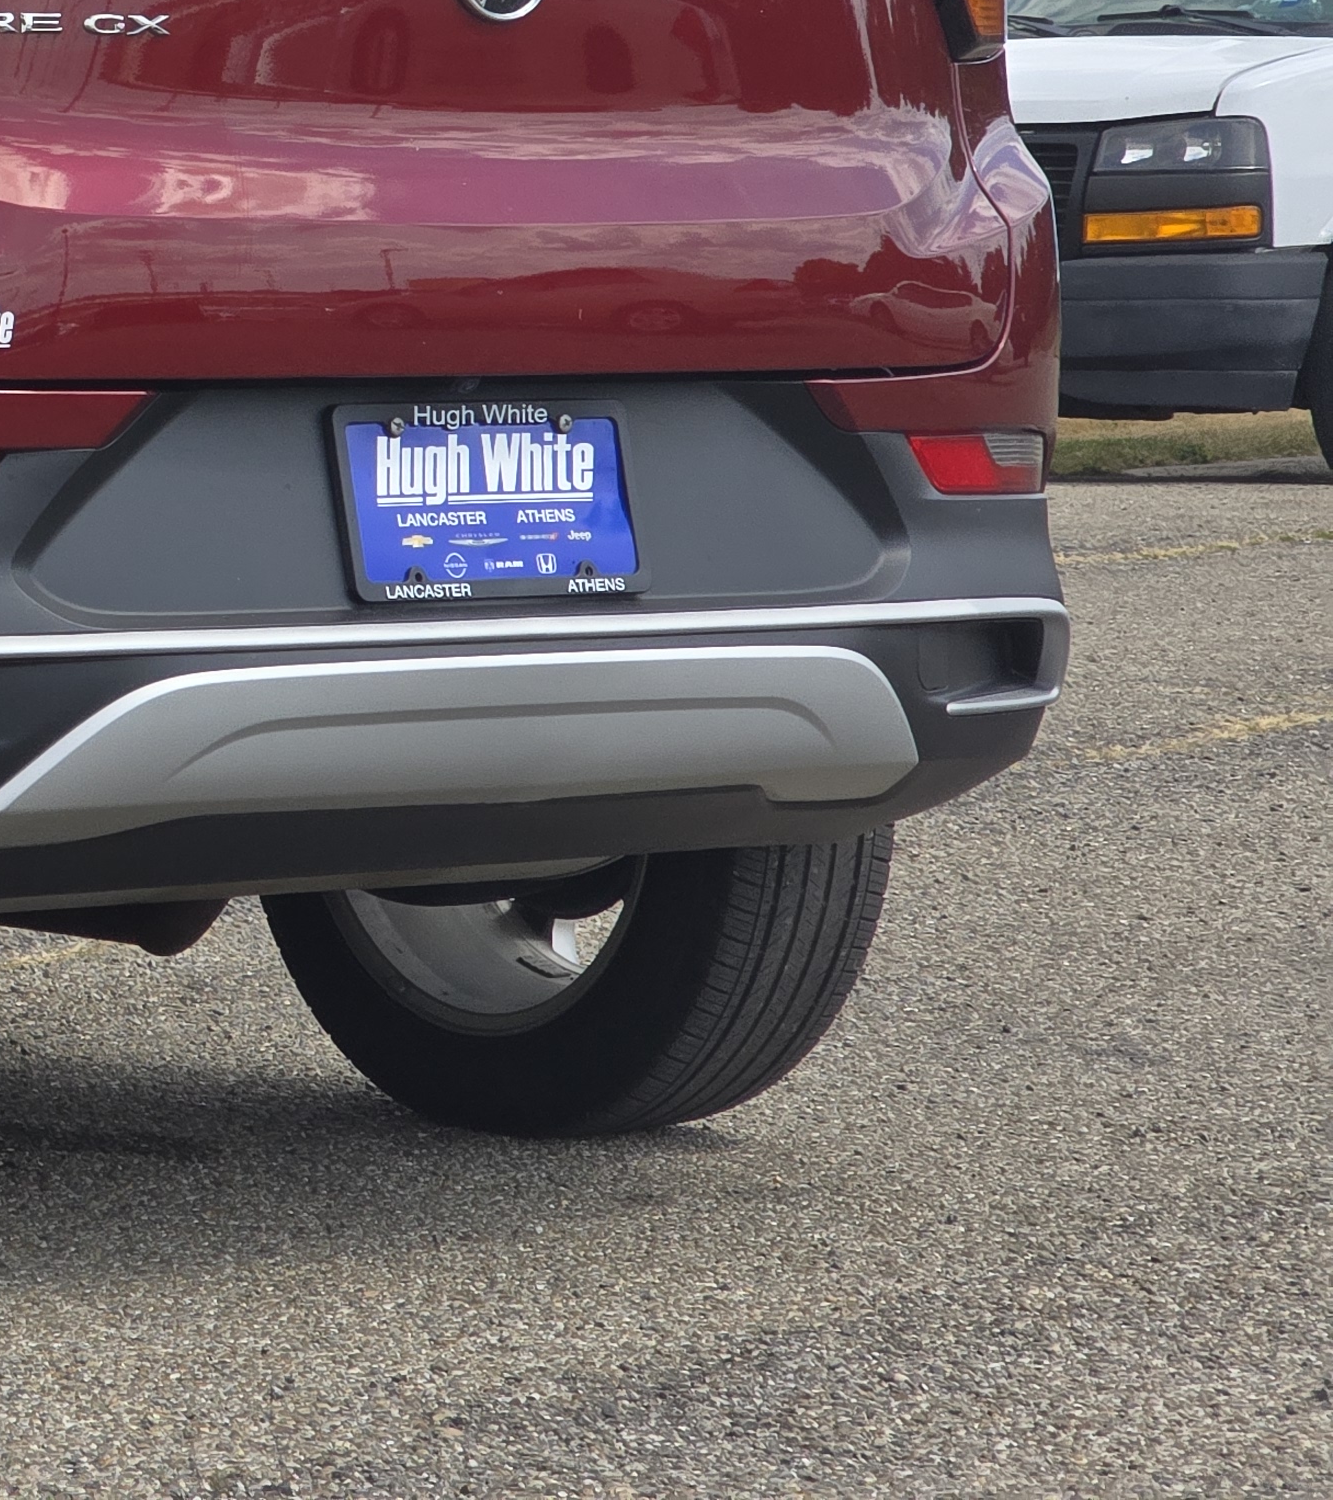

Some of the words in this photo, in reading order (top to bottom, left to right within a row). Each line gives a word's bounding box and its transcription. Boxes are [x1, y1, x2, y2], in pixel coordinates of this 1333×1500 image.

[83, 12, 171, 36] GX
[413, 404, 476, 429] Hugh
[482, 403, 549, 425] White
[376, 433, 470, 506] Hugh
[480, 432, 595, 493] White
[396, 511, 487, 528] LANCASTER
[516, 508, 576, 524] ATHENS
[567, 529, 592, 542] Jeep
[495, 560, 524, 569] RAM
[385, 583, 473, 600] LANCASTER
[567, 577, 626, 594] ATHENS
